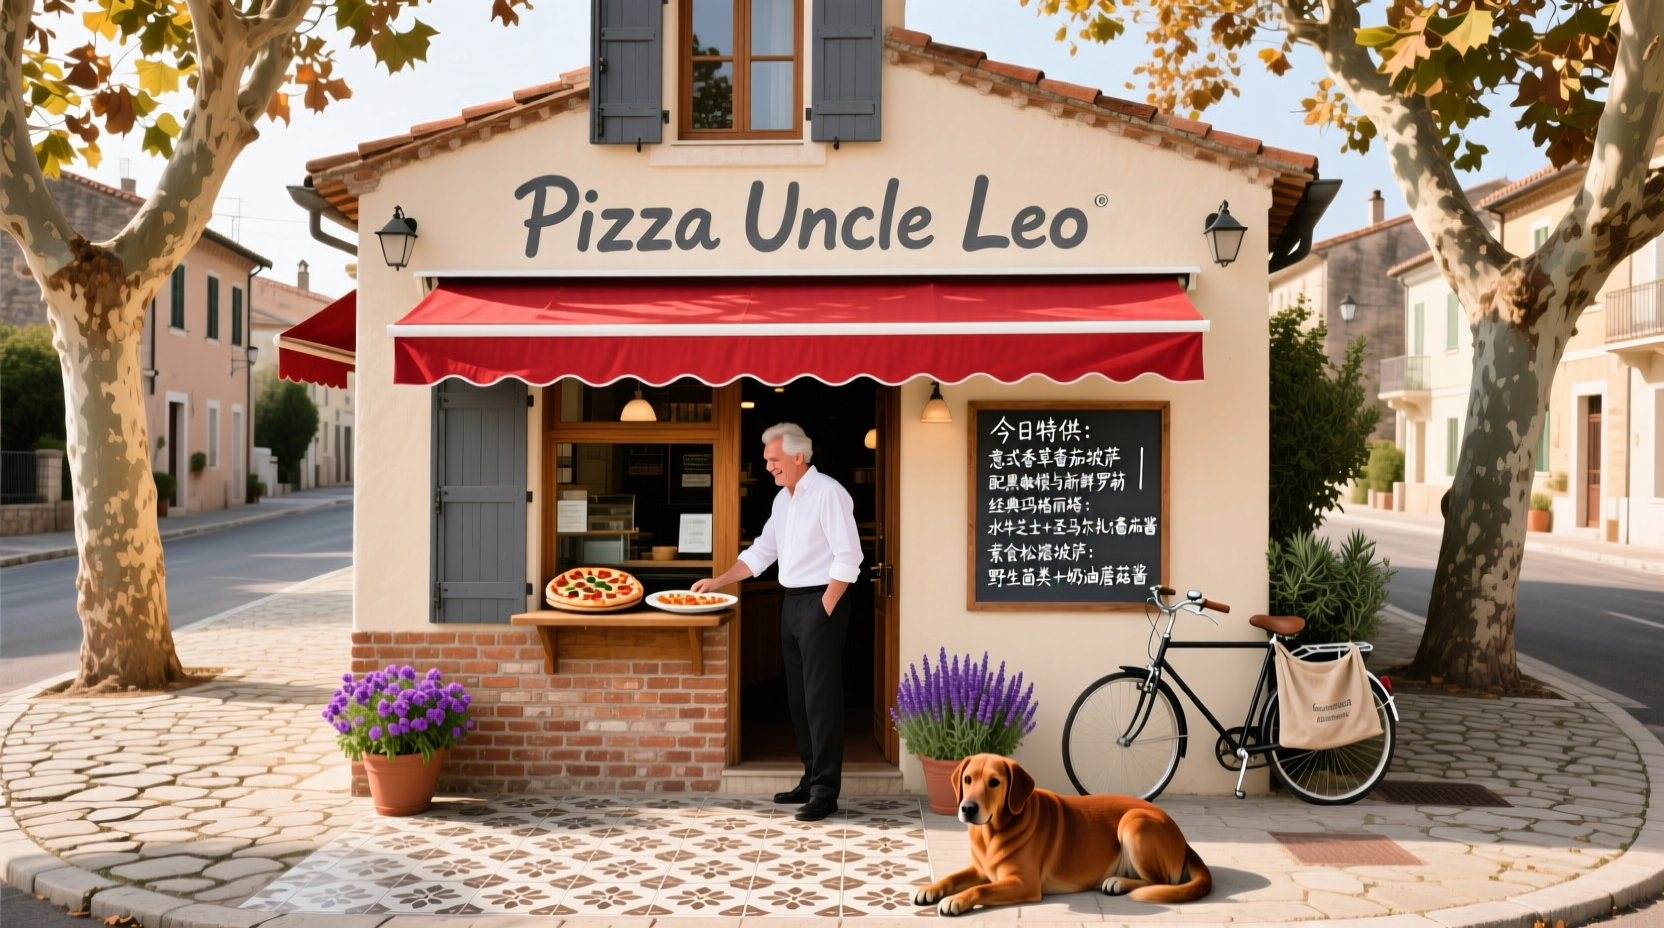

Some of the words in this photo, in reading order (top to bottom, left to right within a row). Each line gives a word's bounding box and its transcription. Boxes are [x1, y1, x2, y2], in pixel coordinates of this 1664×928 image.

[513, 174, 721, 259] Pizza
[745, 177, 935, 253] Uncle
[961, 174, 1089, 253] Leo
